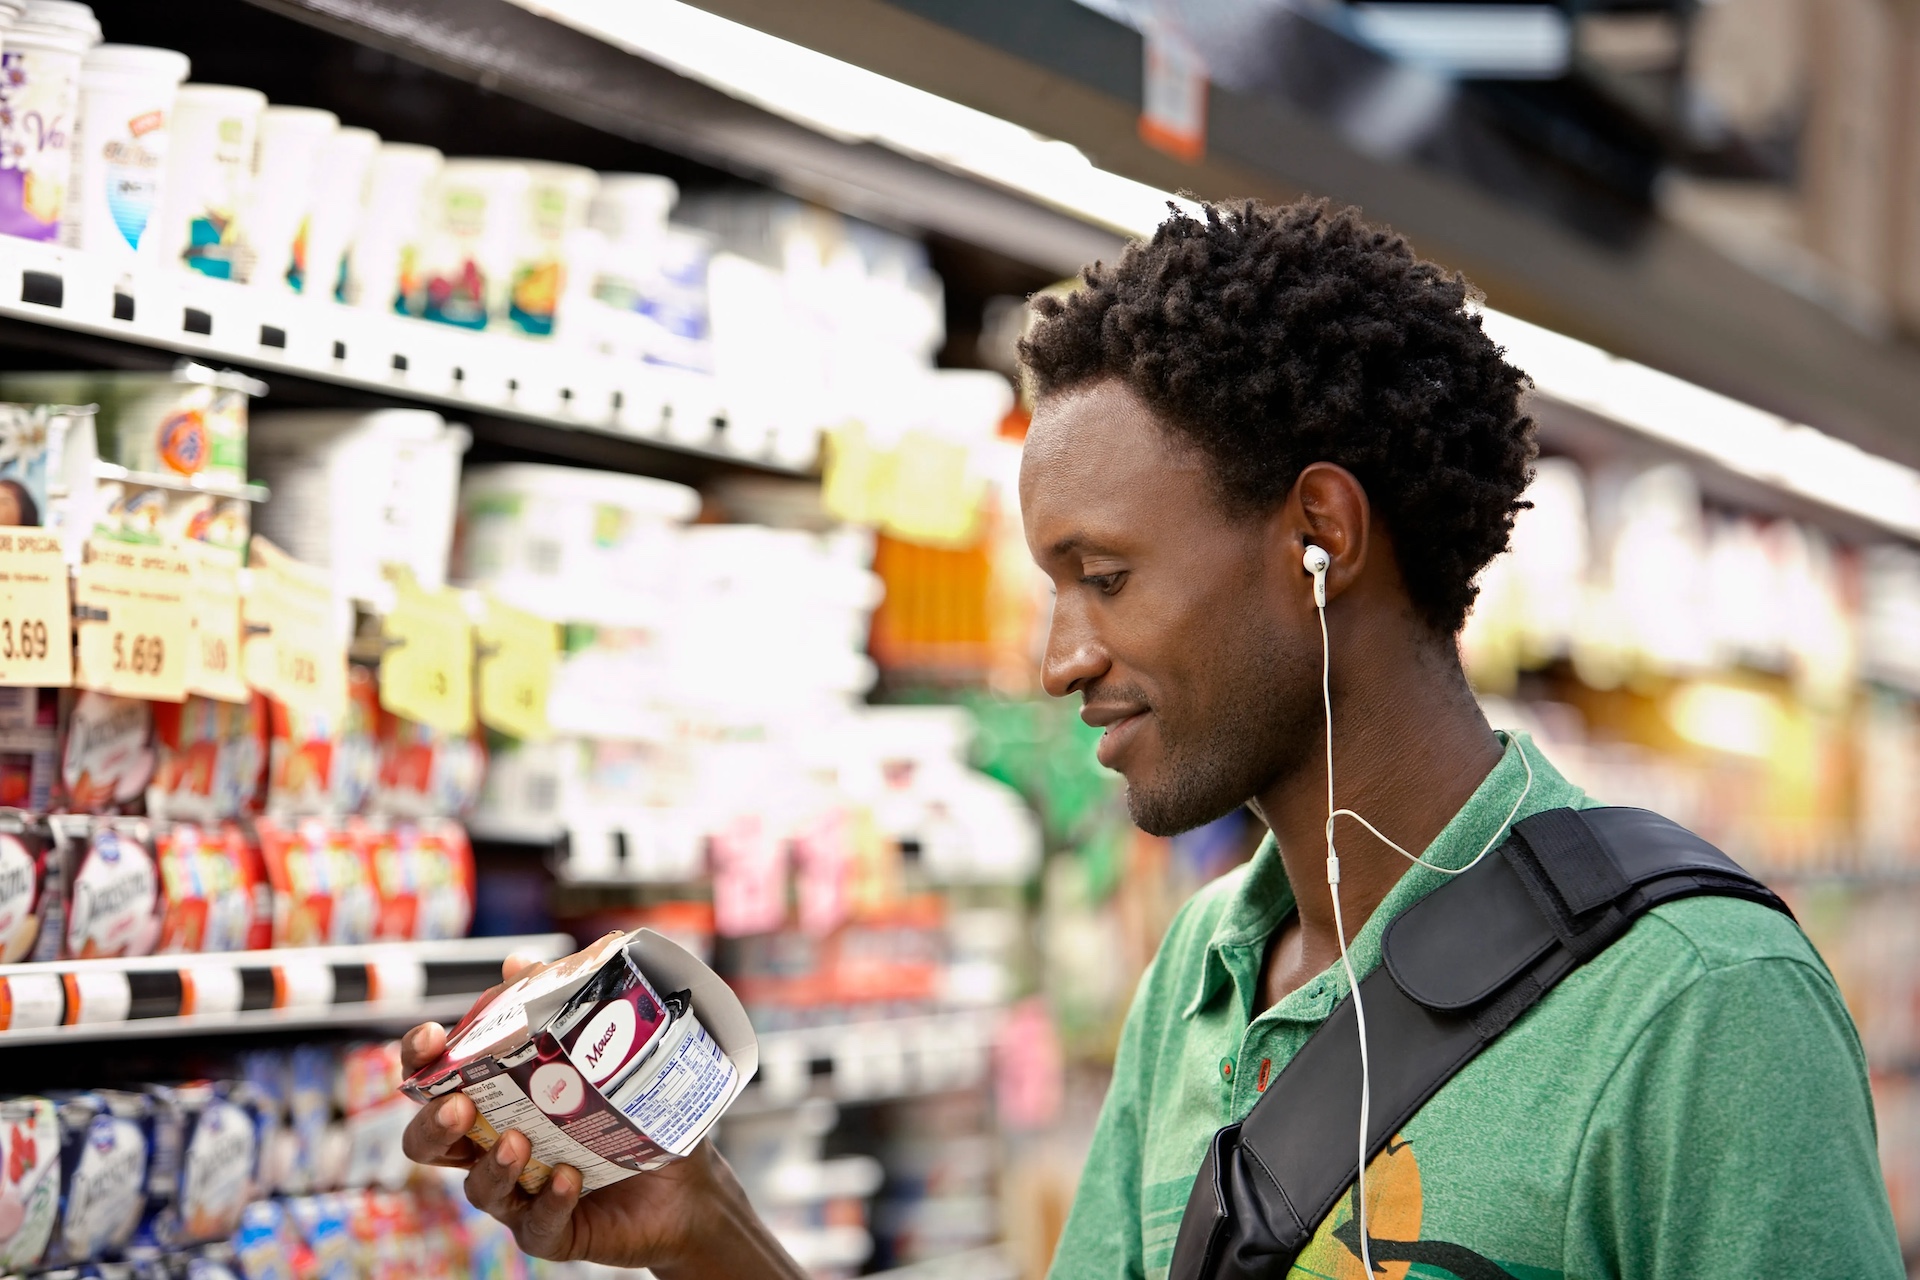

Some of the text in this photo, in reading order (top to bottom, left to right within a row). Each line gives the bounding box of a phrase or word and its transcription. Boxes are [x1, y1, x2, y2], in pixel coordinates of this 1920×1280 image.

[2, 619, 47, 659] 3.69
[113, 631, 164, 676] 5.69
[585, 1022, 617, 1069] Mousse
